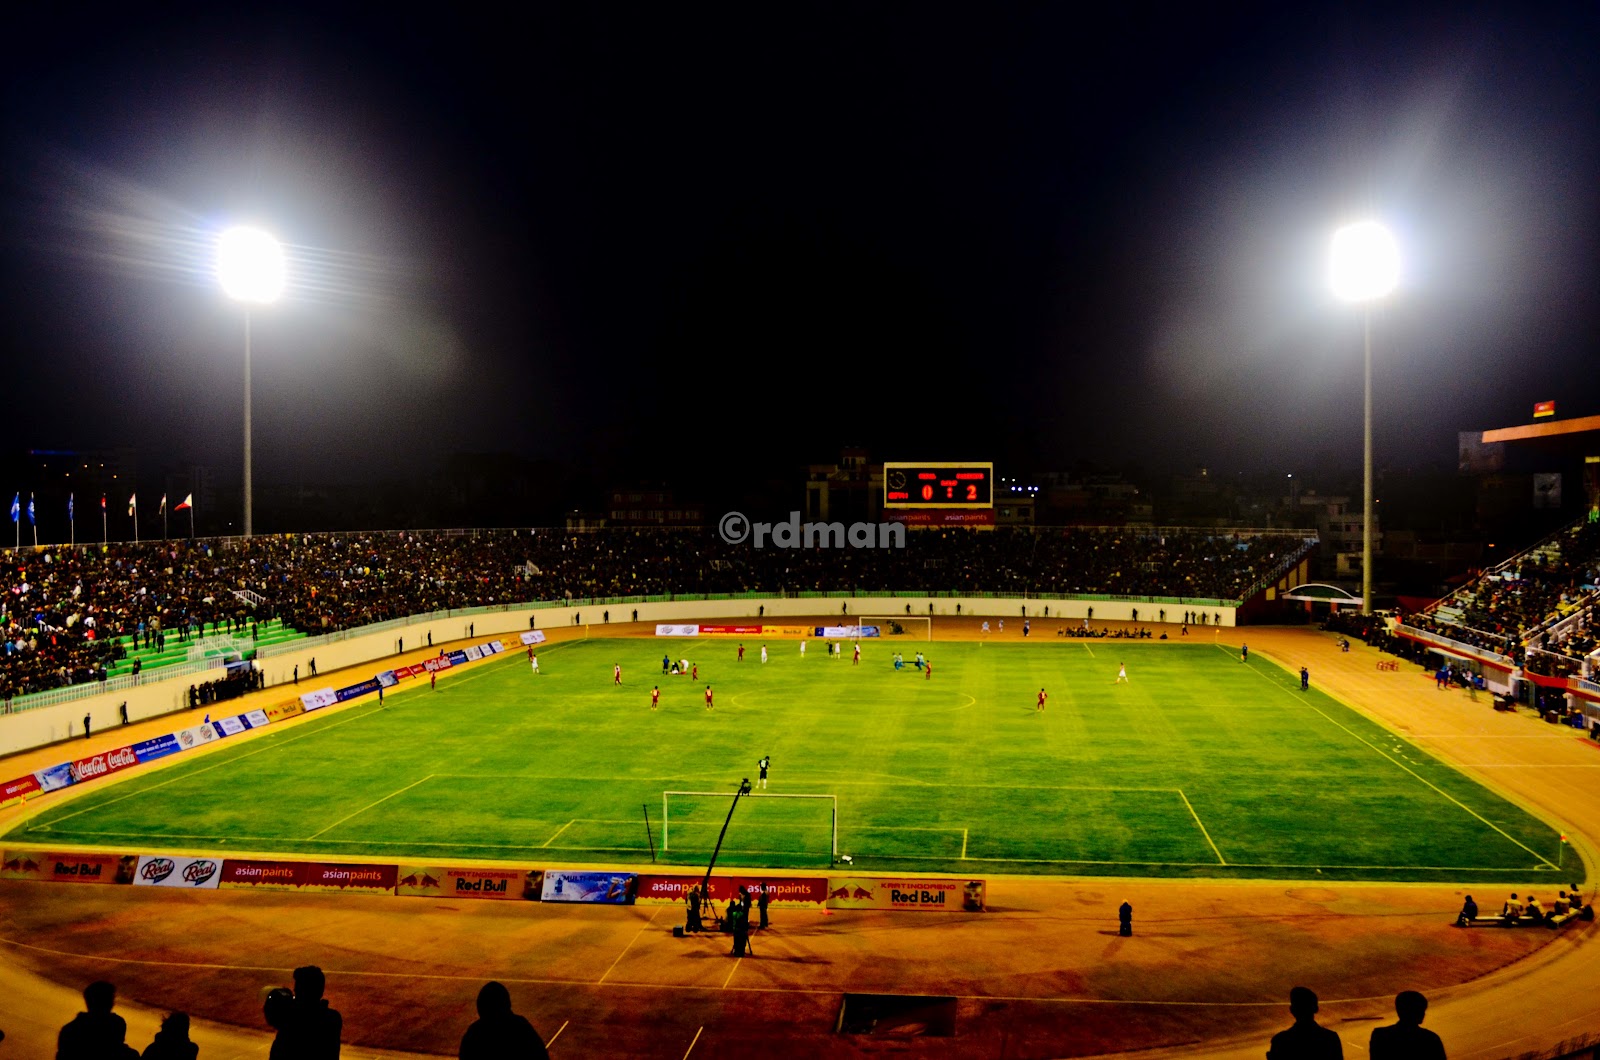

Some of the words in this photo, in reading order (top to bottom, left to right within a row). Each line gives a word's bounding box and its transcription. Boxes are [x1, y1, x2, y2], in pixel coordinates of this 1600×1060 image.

[922, 484, 933, 500] 0
[966, 484, 977, 500] 2
[54, 862, 79, 875] Red
[80, 864, 102, 876] Bull
[142, 861, 171, 880] Real
[184, 862, 213, 882] Real
[455, 877, 482, 891] Red
[484, 879, 508, 892] Bull
[891, 889, 918, 903] Red
[920, 890, 945, 904] Bull
